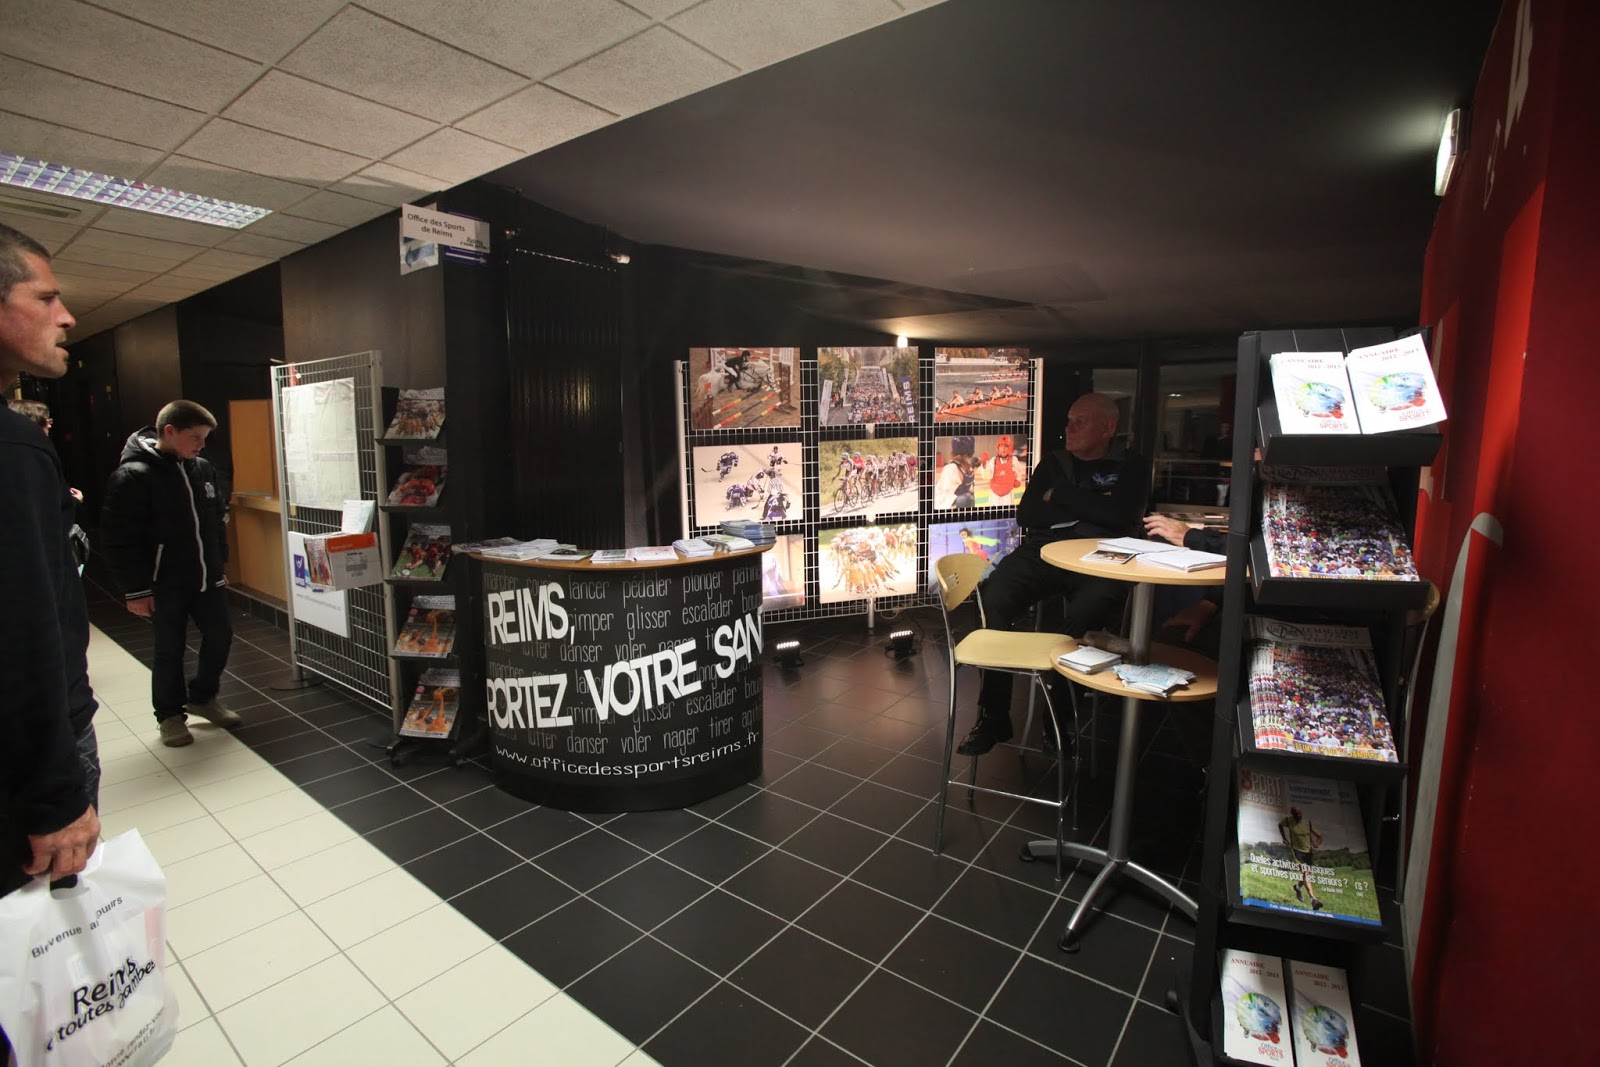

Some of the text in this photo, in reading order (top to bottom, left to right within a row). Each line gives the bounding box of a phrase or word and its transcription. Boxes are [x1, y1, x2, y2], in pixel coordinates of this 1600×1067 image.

[407, 213, 465, 232] Office des Sports
[421, 226, 453, 238] de Reims
[902, 381, 916, 422] REIMS
[569, 574, 610, 600] lancer
[683, 569, 724, 604] plonger
[626, 604, 672, 641] glisser
[682, 593, 734, 625] escalader
[560, 637, 603, 663] danser
[615, 636, 647, 661] voler
[583, 639, 702, 720] VOTRE
[486, 673, 574, 730] PORTEZ
[686, 682, 738, 716] escalader
[566, 725, 609, 754] danser
[620, 730, 652, 754] voler
[663, 726, 700, 756] nager
[709, 716, 734, 739] tirer
[495, 731, 759, 778] www.officedessportsreims.fr
[1250, 852, 1271, 865] Quelles
[1301, 862, 1335, 876] physiques
[1251, 864, 1259, 873] et
[1260, 866, 1289, 879] sportives
[1289, 871, 1304, 882] pour
[1305, 873, 1316, 883] les
[1317, 876, 1342, 888] seniors
[1231, 958, 1264, 968] ANNUAIRE
[1249, 968, 1262, 976] 2012
[1266, 971, 1280, 979] 2013
[1294, 969, 1329, 980] ANNUAIRE
[1313, 980, 1327, 988] 2012
[57, 1001, 114, 1041] toutes
[1258, 1046, 1284, 1060] SPORTS
